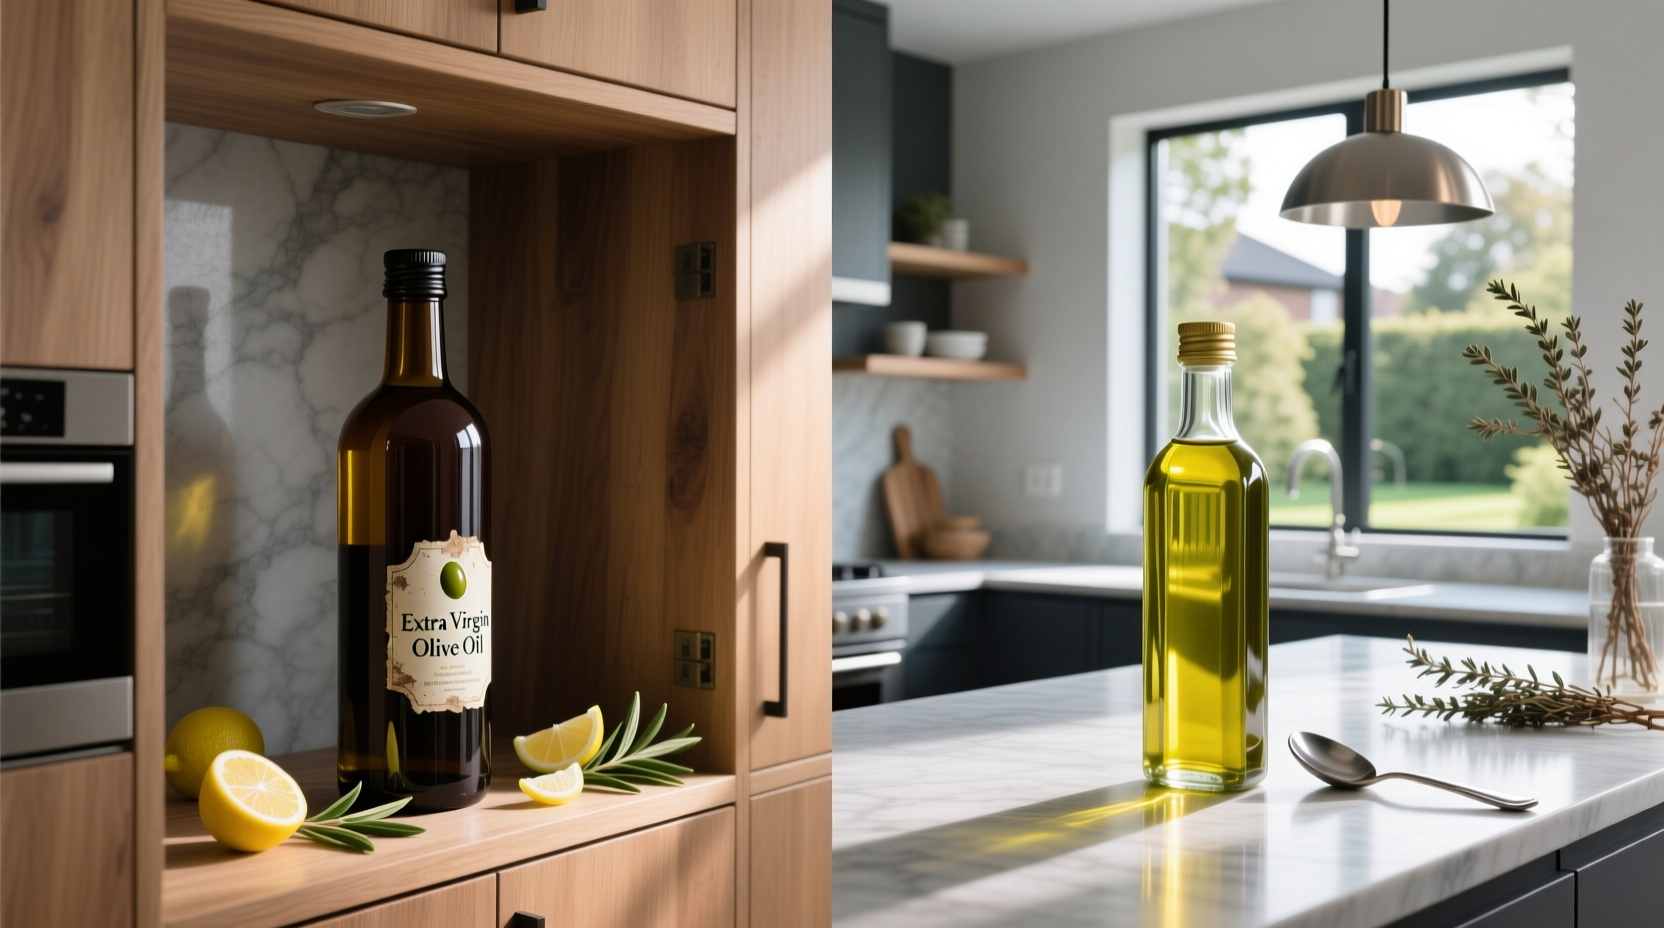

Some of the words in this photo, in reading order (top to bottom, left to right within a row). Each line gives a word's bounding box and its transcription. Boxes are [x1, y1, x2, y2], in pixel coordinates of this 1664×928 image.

[401, 613, 447, 632] Extra
[449, 610, 489, 633] Virgin
[412, 637, 459, 657] Olive
[462, 634, 484, 655] Oil
